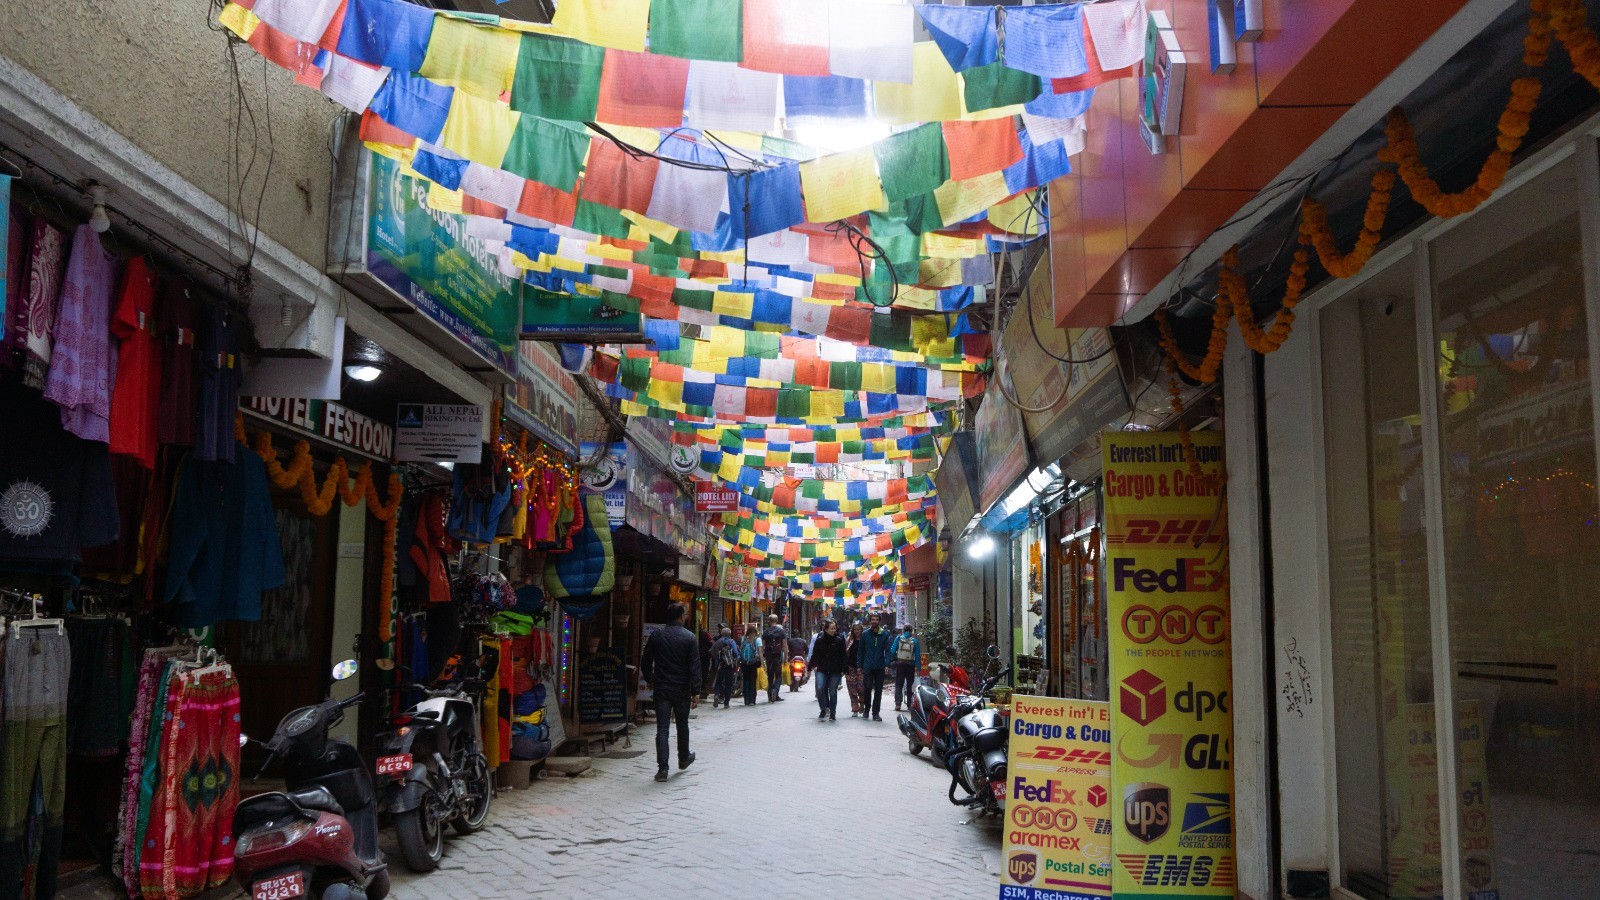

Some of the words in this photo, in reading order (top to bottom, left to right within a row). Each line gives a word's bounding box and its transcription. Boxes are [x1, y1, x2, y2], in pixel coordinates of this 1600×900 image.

[377, 226, 395, 246] Hotel
[410, 281, 438, 314] Website:
[424, 406, 446, 415] ALL
[449, 406, 482, 416] NEPAL
[325, 402, 392, 459] FESTOON
[1110, 444, 1156, 463] Everest
[1105, 469, 1154, 500] Cargo
[1158, 474, 1170, 497] &
[697, 492, 719, 501] HOTEL
[721, 492, 736, 501] LILY
[1124, 519, 1221, 543] DHL
[1113, 557, 1224, 593] FedEx
[1126, 649, 1142, 657] THE
[1145, 649, 1181, 657] PEOPLE
[1015, 701, 1065, 717] Everest
[1014, 719, 1062, 740] Cargo
[1066, 726, 1077, 740] &
[1032, 745, 1112, 766] DHL
[1057, 766, 1097, 775] EXPRESS
[1013, 776, 1077, 805] FedEx
[1126, 801, 1169, 835] ups
[1009, 830, 1081, 851] aramex
[1009, 859, 1036, 880] ups
[1045, 858, 1085, 874] Postal
[1142, 855, 1213, 887] EMS
[1003, 886, 1030, 899] SIM,
